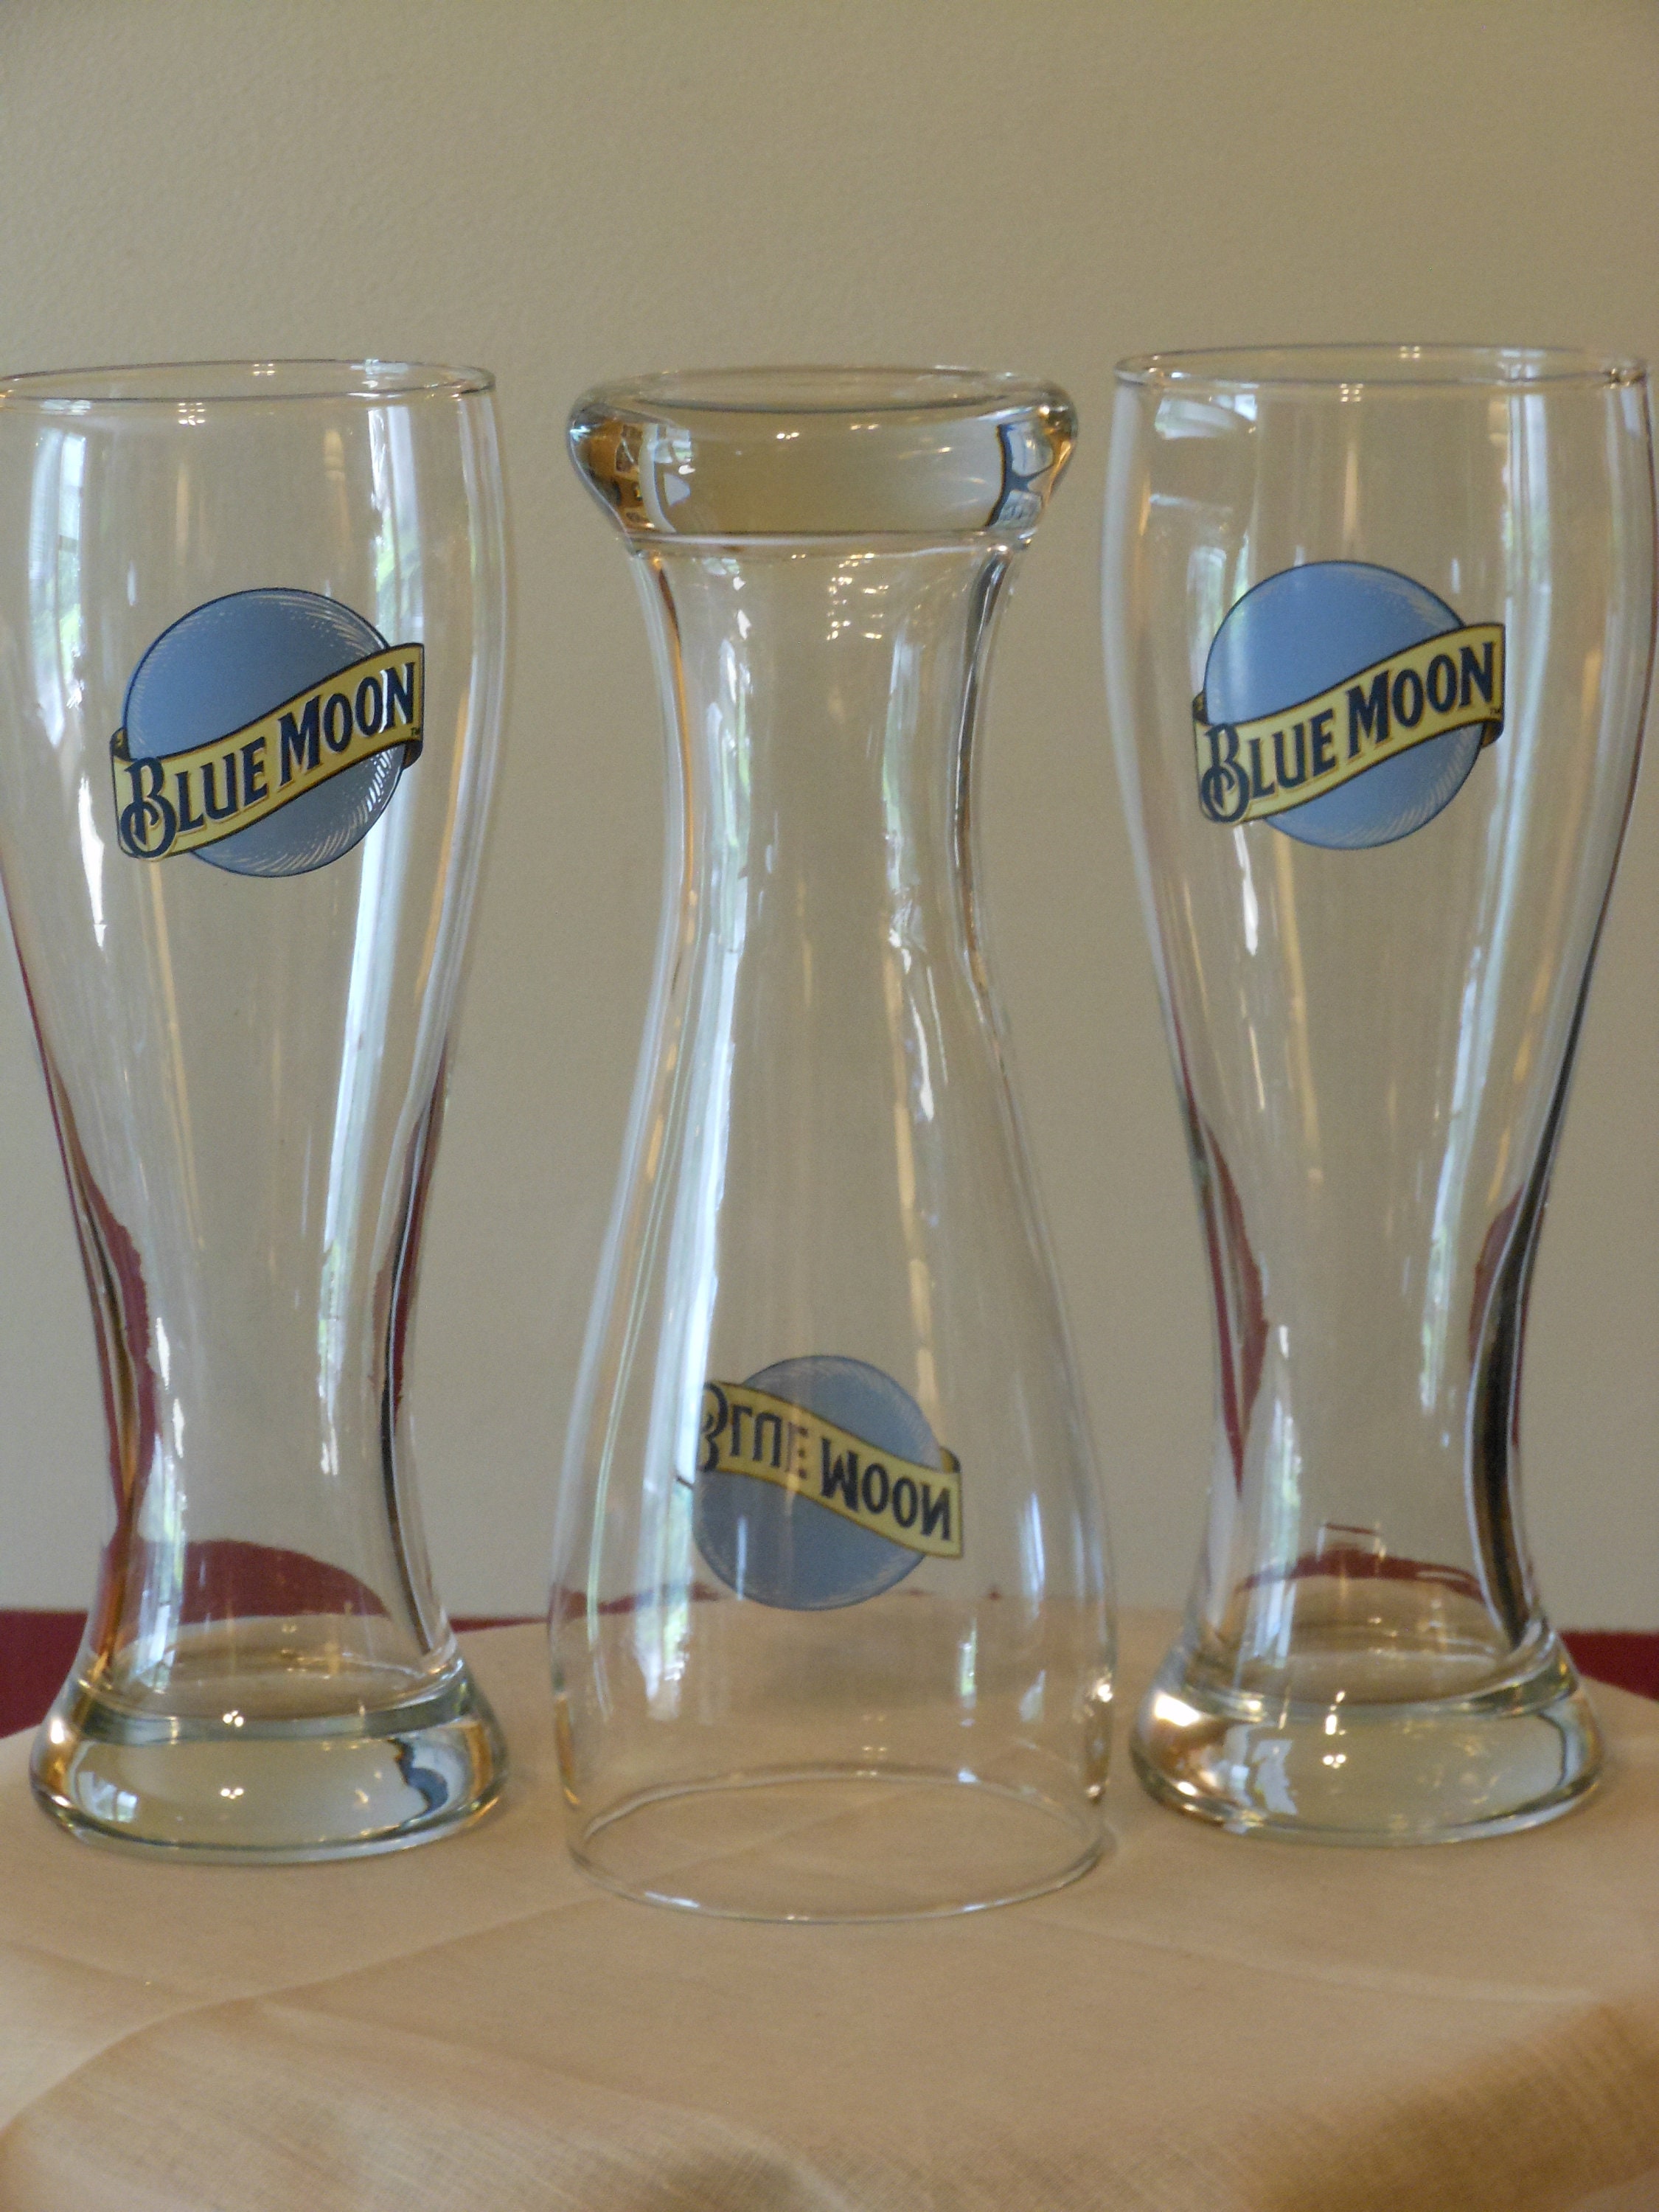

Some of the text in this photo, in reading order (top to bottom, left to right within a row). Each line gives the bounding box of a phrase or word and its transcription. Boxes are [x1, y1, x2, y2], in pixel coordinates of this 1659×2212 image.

[120, 662, 416, 858] BLUE MOON
[1201, 641, 1494, 822] BLUE MOON
